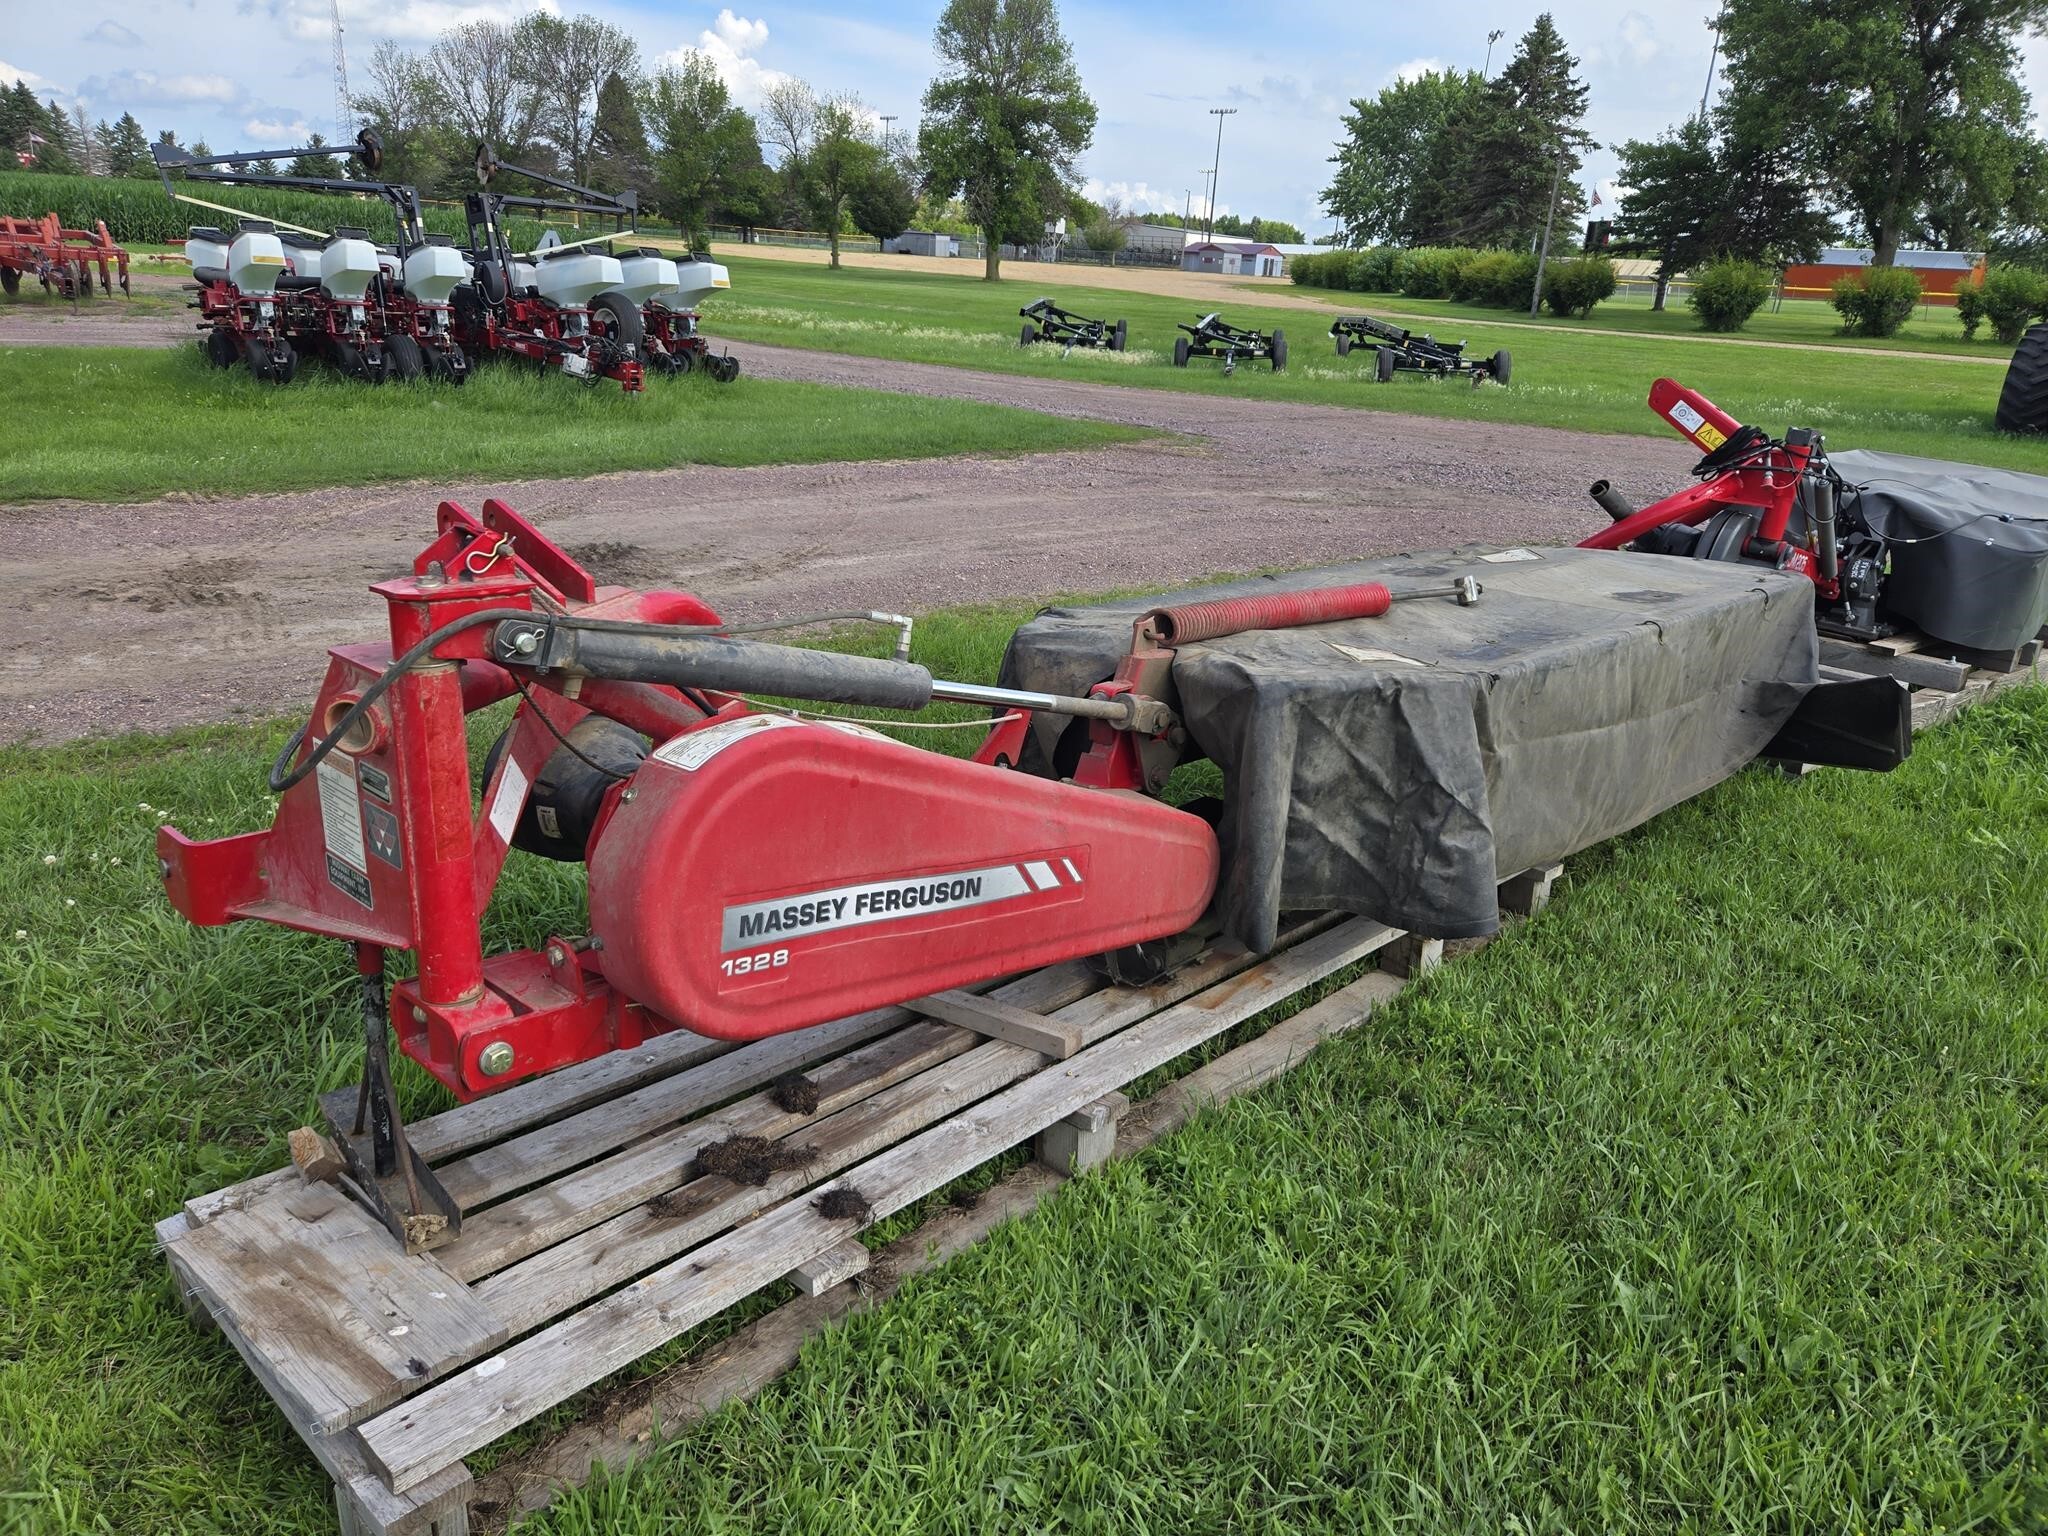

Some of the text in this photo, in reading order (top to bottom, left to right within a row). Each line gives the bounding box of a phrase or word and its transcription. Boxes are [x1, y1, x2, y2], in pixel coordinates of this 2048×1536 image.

[738, 876, 982, 939] MASSEY FERGUSON
[720, 948, 790, 978] 1328
